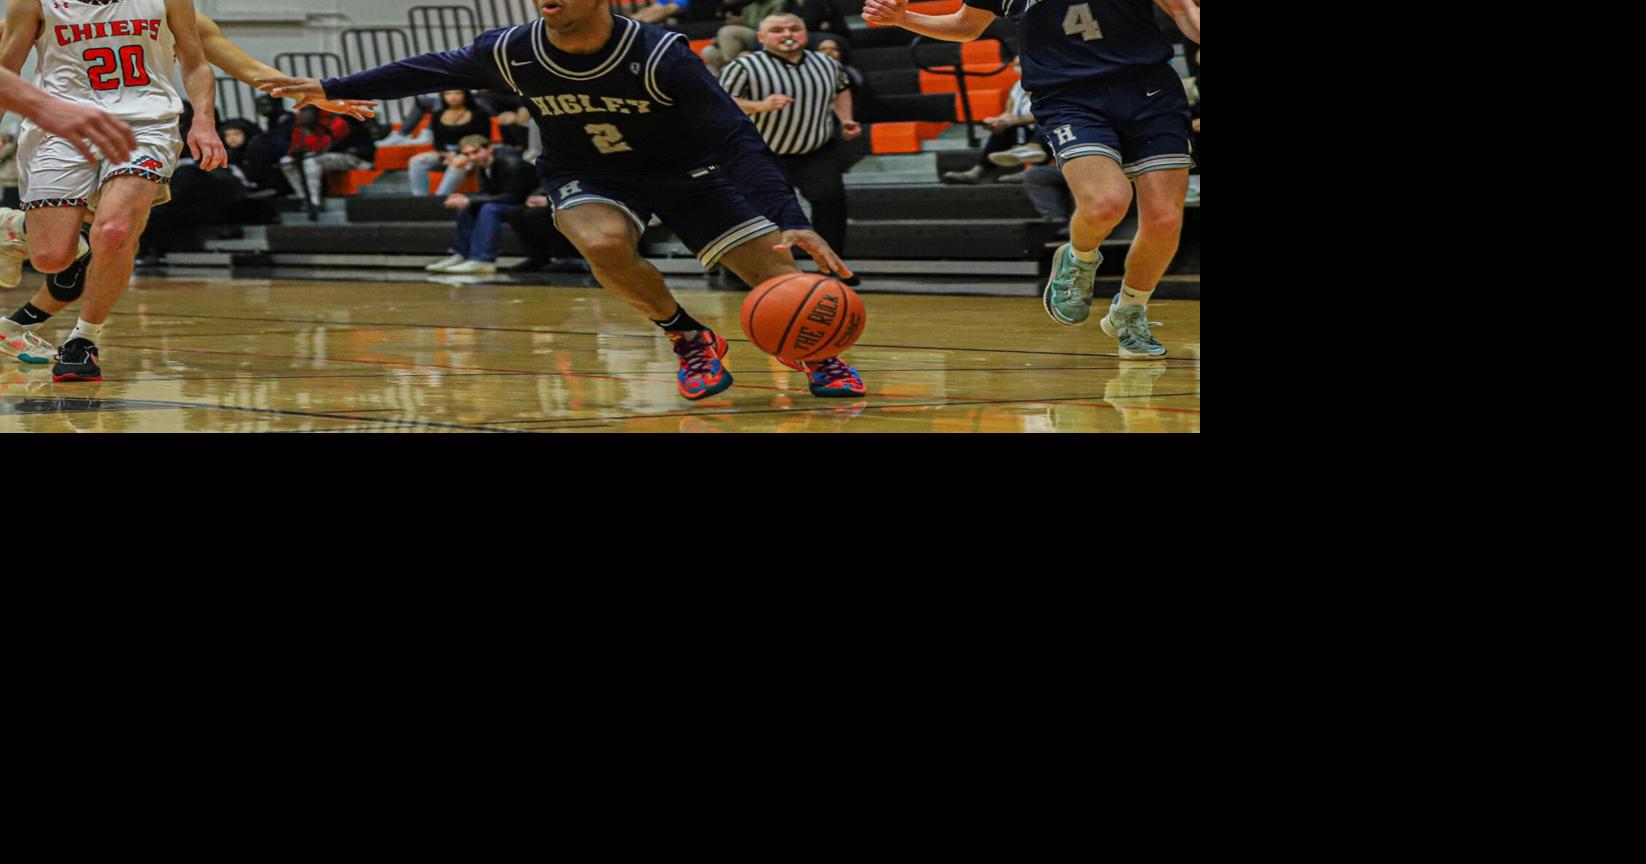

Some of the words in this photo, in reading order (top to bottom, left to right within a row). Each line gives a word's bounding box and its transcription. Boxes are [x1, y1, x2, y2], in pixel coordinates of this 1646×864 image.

[54, 19, 162, 47] CHIEFS
[1062, 3, 1104, 41] 4
[82, 44, 151, 91] 20
[530, 94, 651, 116] HIGLEY
[583, 123, 633, 155] 2
[1053, 124, 1077, 146] H
[558, 180, 583, 200] H
[793, 326, 825, 351] THE
